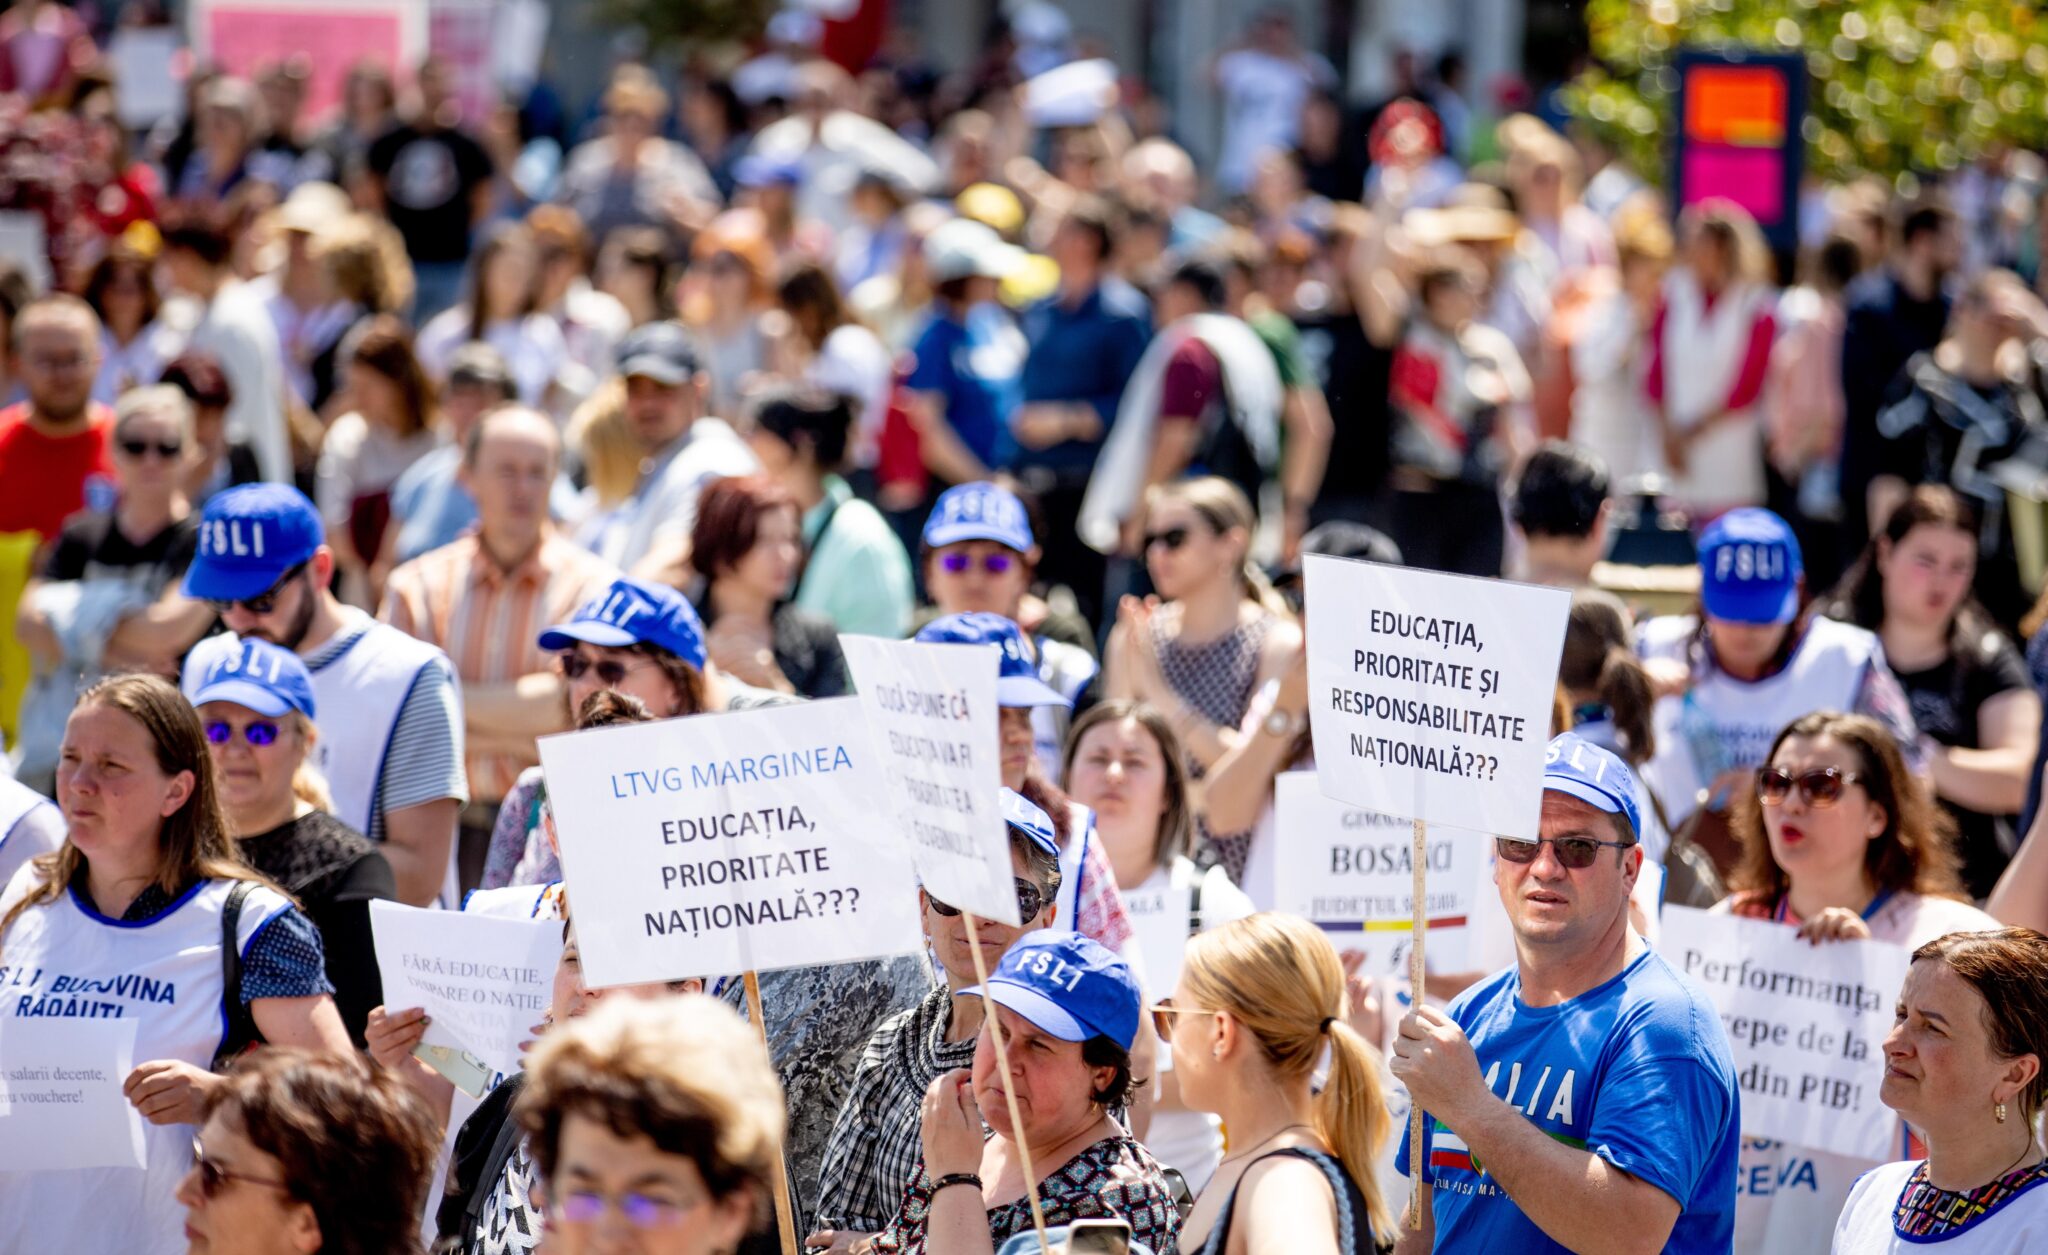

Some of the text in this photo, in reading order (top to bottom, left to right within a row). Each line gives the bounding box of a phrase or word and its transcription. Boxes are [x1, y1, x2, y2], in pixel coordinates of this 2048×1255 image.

[201, 518, 264, 558] FSLI
[1715, 543, 1785, 582] FSLI
[1371, 609, 1484, 652] EDUCAȚIA,
[1354, 650, 1499, 698] PRIORITATE ȘI
[1332, 688, 1525, 742] RESPONSABILITATE
[611, 745, 853, 799] LTVG MARGINEA
[1350, 733, 1499, 782] NAȚIONALĂ???
[1544, 739, 1608, 784] SLI
[661, 805, 816, 845] EDUCAȚIA,
[662, 847, 830, 890] PRIORITATE
[645, 887, 860, 938] NAȚIONALĂ???
[402, 953, 445, 976] FĂRĂ
[1015, 951, 1084, 993] FSLI
[1684, 949, 1882, 1019] Performanța
[473, 990, 486, 1005] O
[487, 992, 544, 1011] NAȚIE
[1797, 1022, 1834, 1055] de
[1843, 1030, 1868, 1061] la
[9, 1066, 50, 1082] salarii
[53, 1066, 107, 1083] decente,
[1740, 1063, 1863, 1113] din PIB!
[21, 1089, 84, 1105] vouchere!
